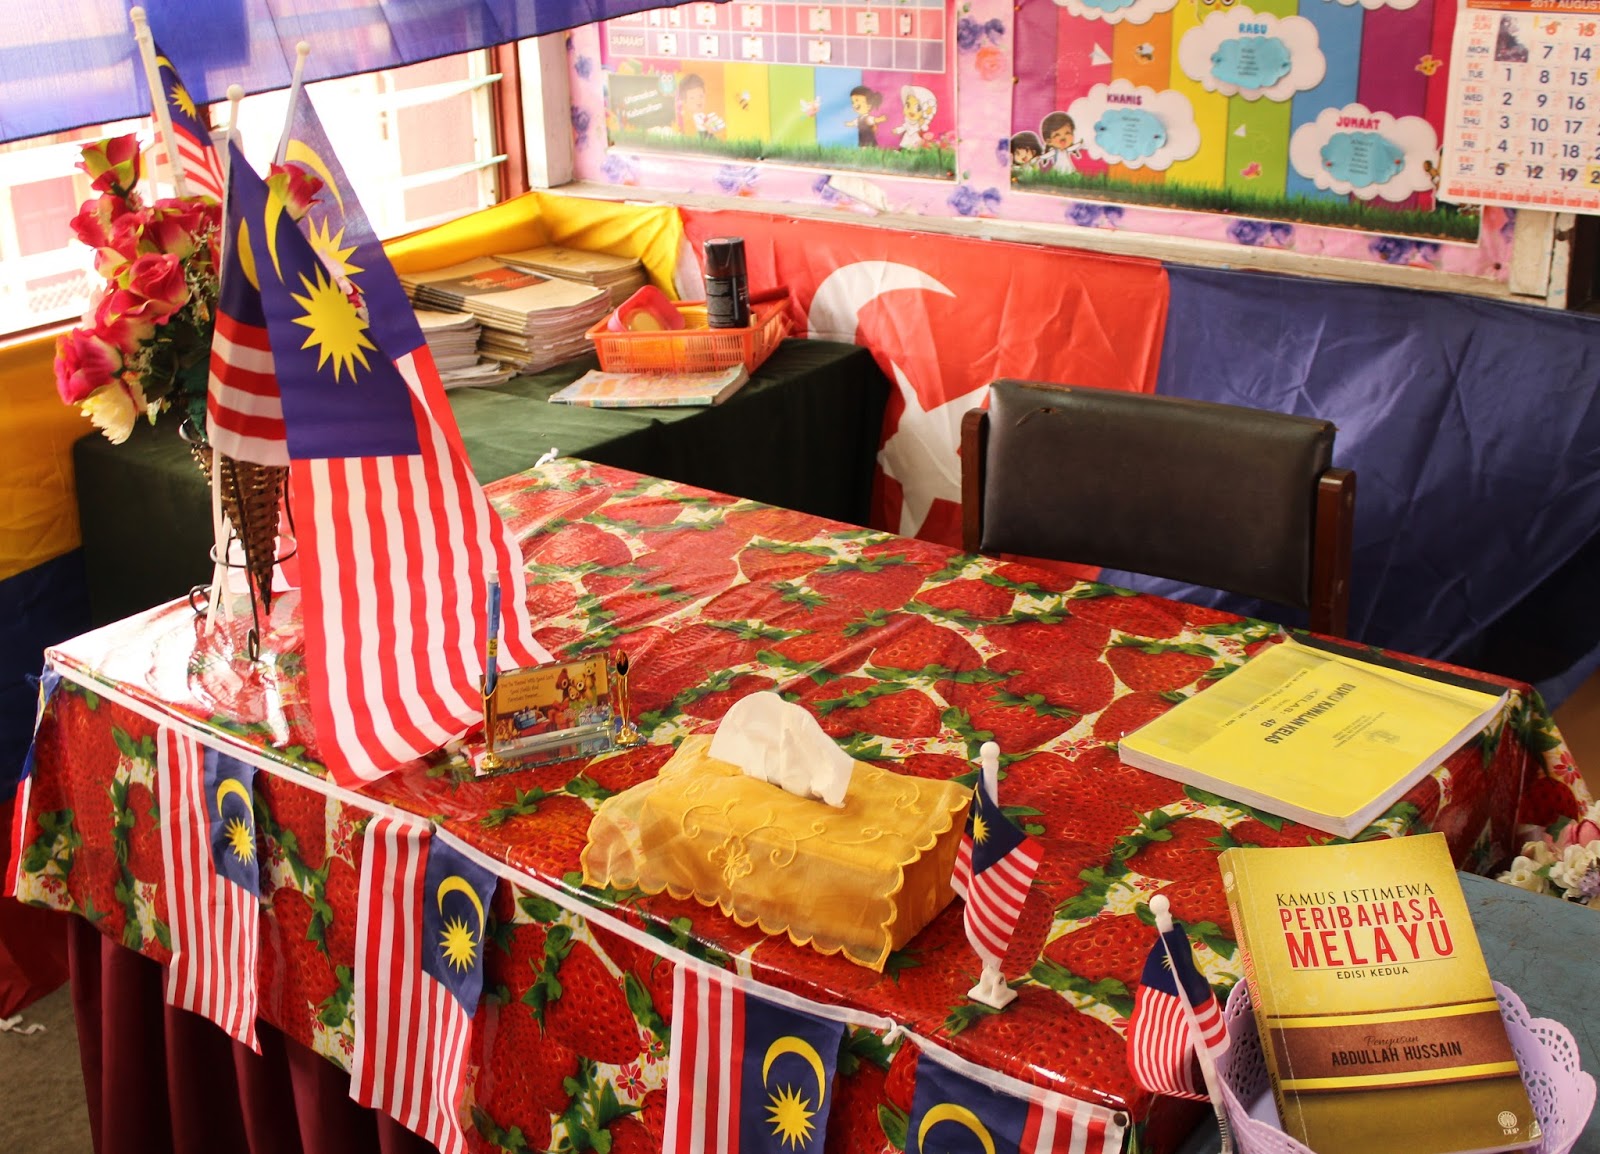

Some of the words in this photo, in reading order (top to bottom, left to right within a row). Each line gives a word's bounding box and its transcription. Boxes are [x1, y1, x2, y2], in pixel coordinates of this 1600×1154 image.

[1238, 22, 1268, 35] RABU
[1467, 46, 1489, 54] MON
[1543, 45, 1554, 59] 7
[1573, 47, 1591, 61] 14
[1468, 70, 1484, 78] TUE
[1505, 68, 1512, 81] 1
[1539, 69, 1550, 84] 8
[1570, 71, 1589, 86] 15
[1106, 93, 1143, 106] KHAMIS
[1464, 94, 1483, 102] WED
[1502, 92, 1513, 106] 2
[1537, 94, 1548, 108] 9
[1568, 95, 1586, 111] 16
[1335, 116, 1382, 131] JUMAAT
[1463, 117, 1480, 125] THU
[1499, 115, 1510, 129] 3
[1531, 118, 1549, 132] 10
[1564, 120, 1583, 134] 17
[1463, 140, 1475, 149] FRI
[1497, 139, 1508, 153] 4
[1530, 142, 1544, 156] 11
[1562, 144, 1580, 159] 18
[1460, 163, 1474, 172] SAT
[1495, 162, 1506, 176] 5
[1526, 165, 1544, 179] 12
[1560, 167, 1578, 182] 19
[1260, 718, 1277, 728] 4B
[1290, 700, 1335, 727] KAWALAN
[1264, 723, 1300, 745] KELAS
[1276, 891, 1337, 907] KAMUS
[1343, 882, 1435, 904] ISTIMEWA
[1279, 896, 1445, 931] PERIBAHASA
[1284, 919, 1455, 969] MELAYU
[1242, 949, 1263, 1011] MELAYU
[1336, 969, 1366, 980] EDISI
[1370, 965, 1410, 978] KEDUA
[1364, 1035, 1420, 1049] Penyusun
[1331, 1046, 1400, 1068] ABDULLAH
[1404, 1041, 1463, 1061] HUSSAIN
